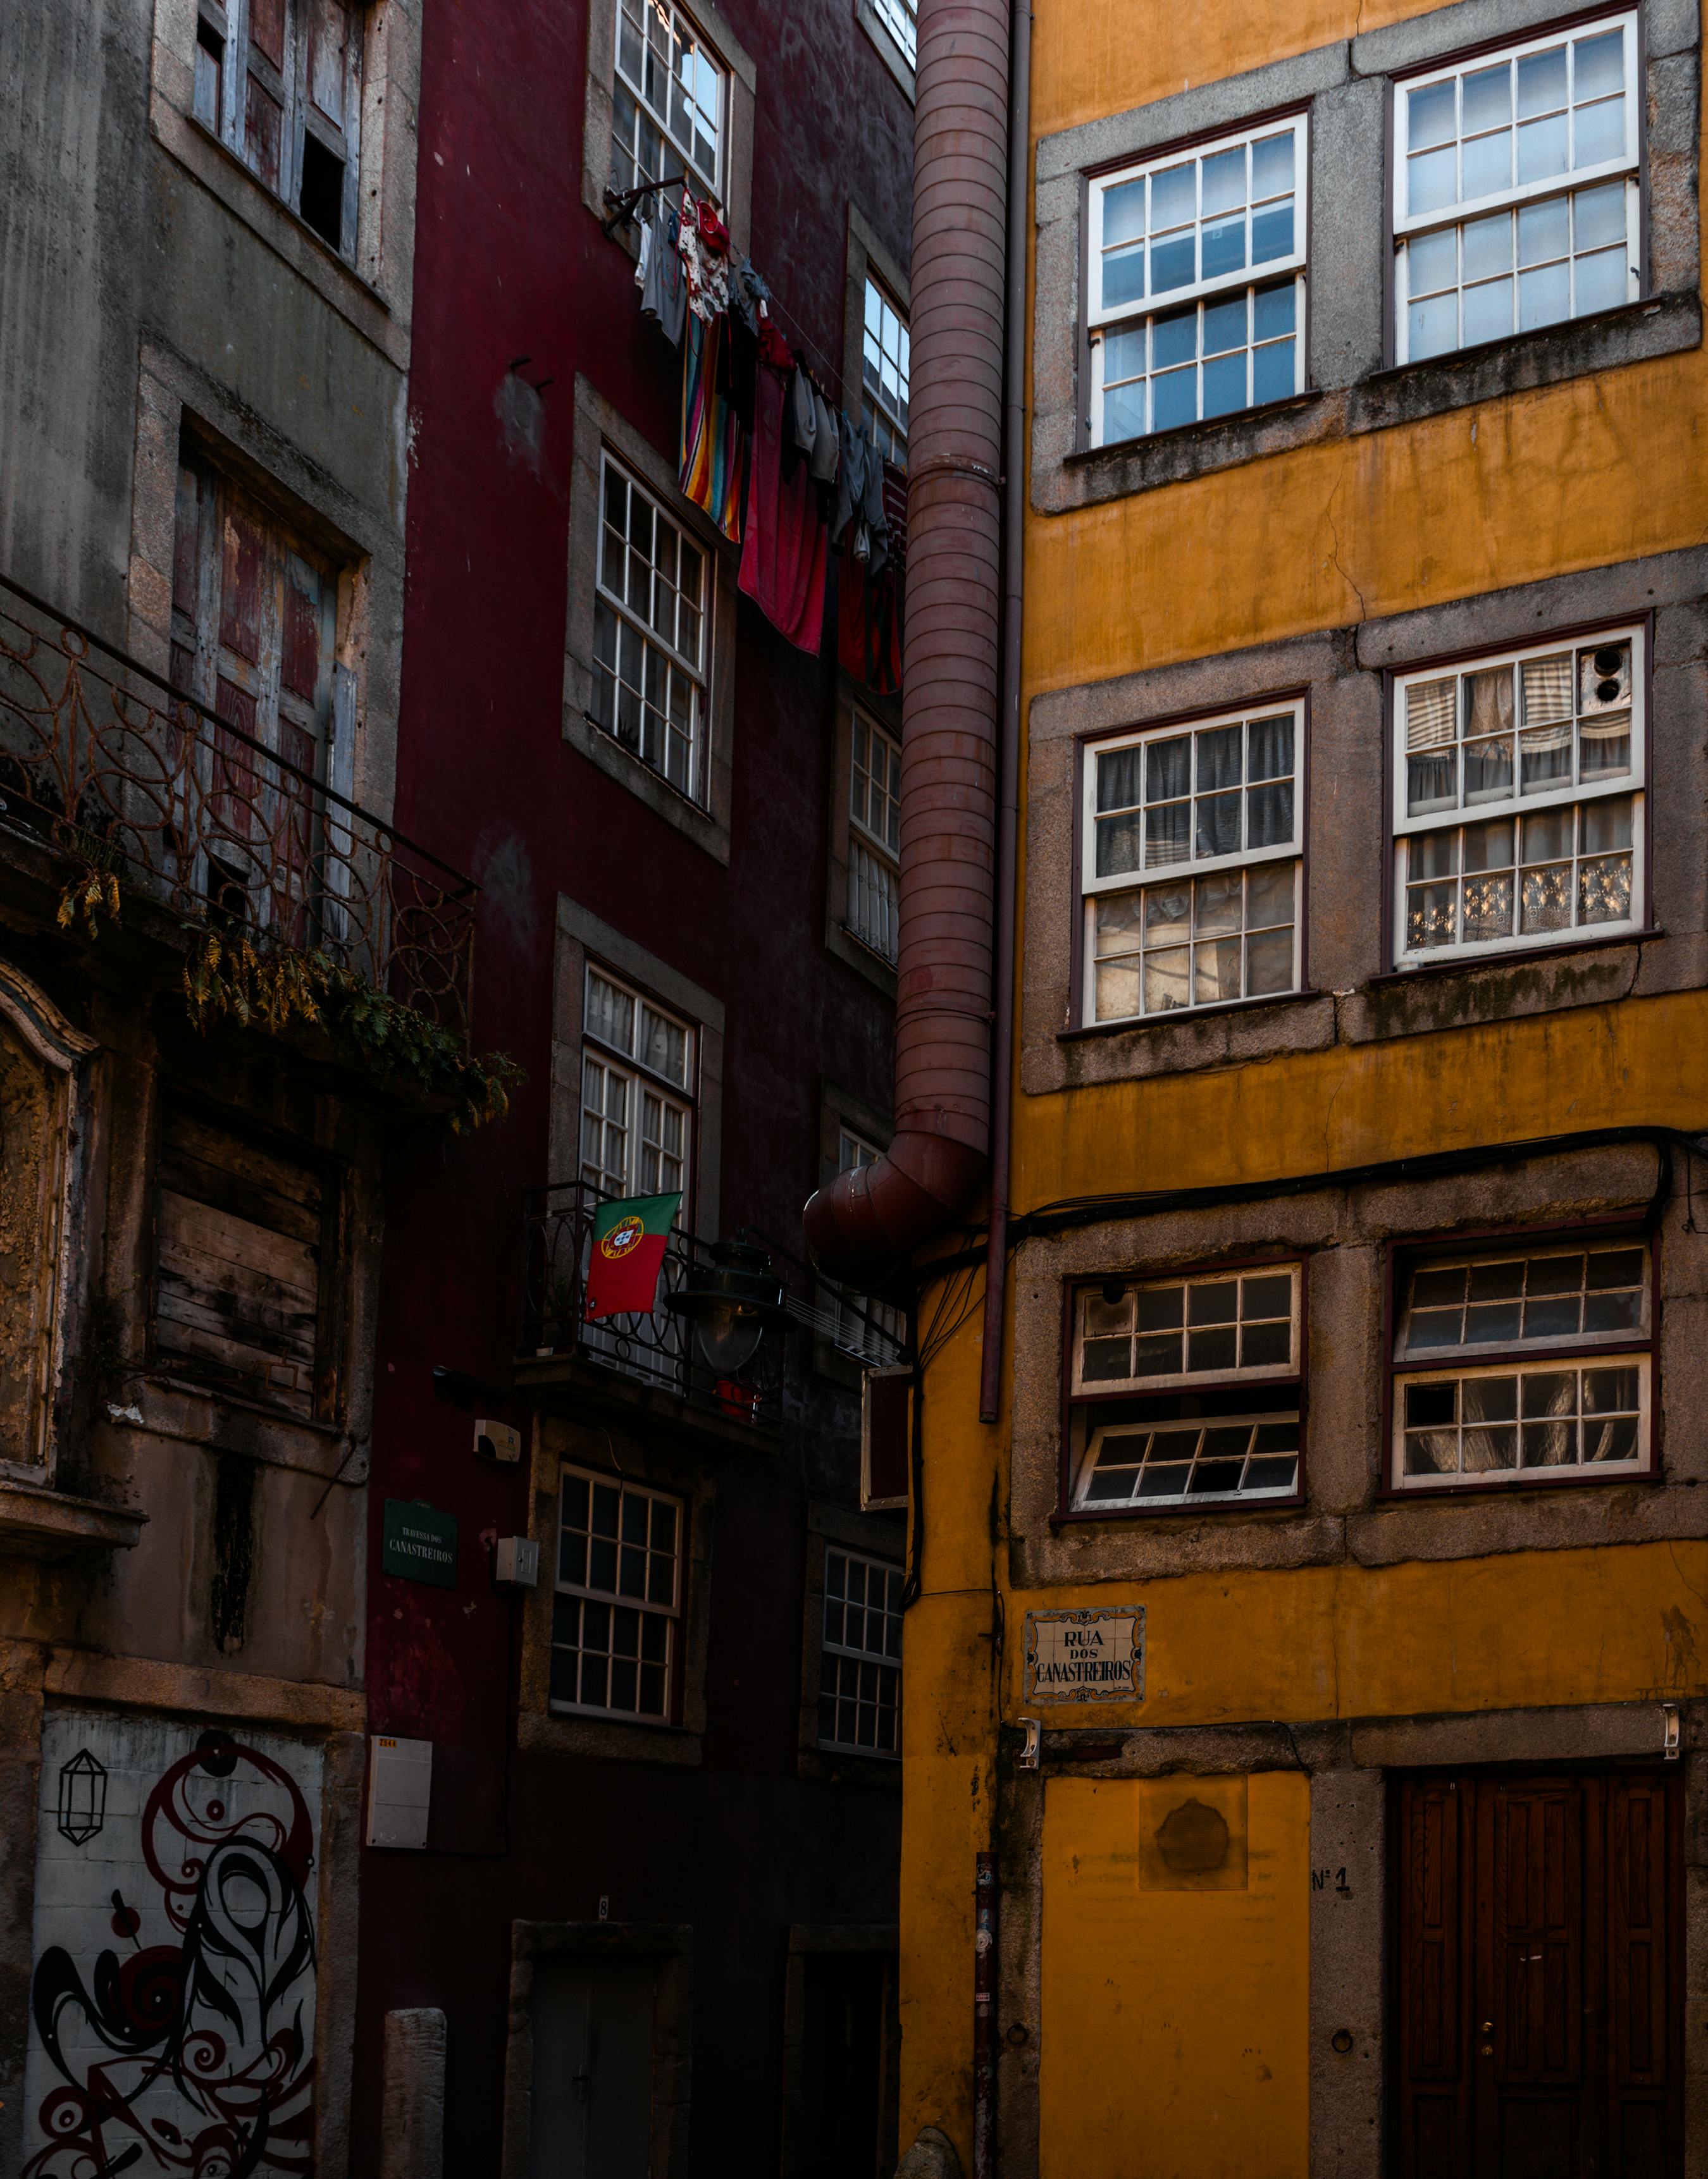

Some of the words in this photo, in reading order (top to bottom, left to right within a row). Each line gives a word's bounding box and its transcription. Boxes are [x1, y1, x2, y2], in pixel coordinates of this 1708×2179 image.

[402, 1527, 430, 1541] TRAVESSA
[430, 1534, 442, 1544] DOS
[389, 1538, 453, 1564] CANASTREIROS
[1065, 1630, 1105, 1646] RUA
[1070, 1648, 1098, 1659] DOS
[1037, 1660, 1131, 1682] CANASTREIROS
[1335, 1867, 1350, 1892] 1
[600, 1901, 607, 1916] 8
